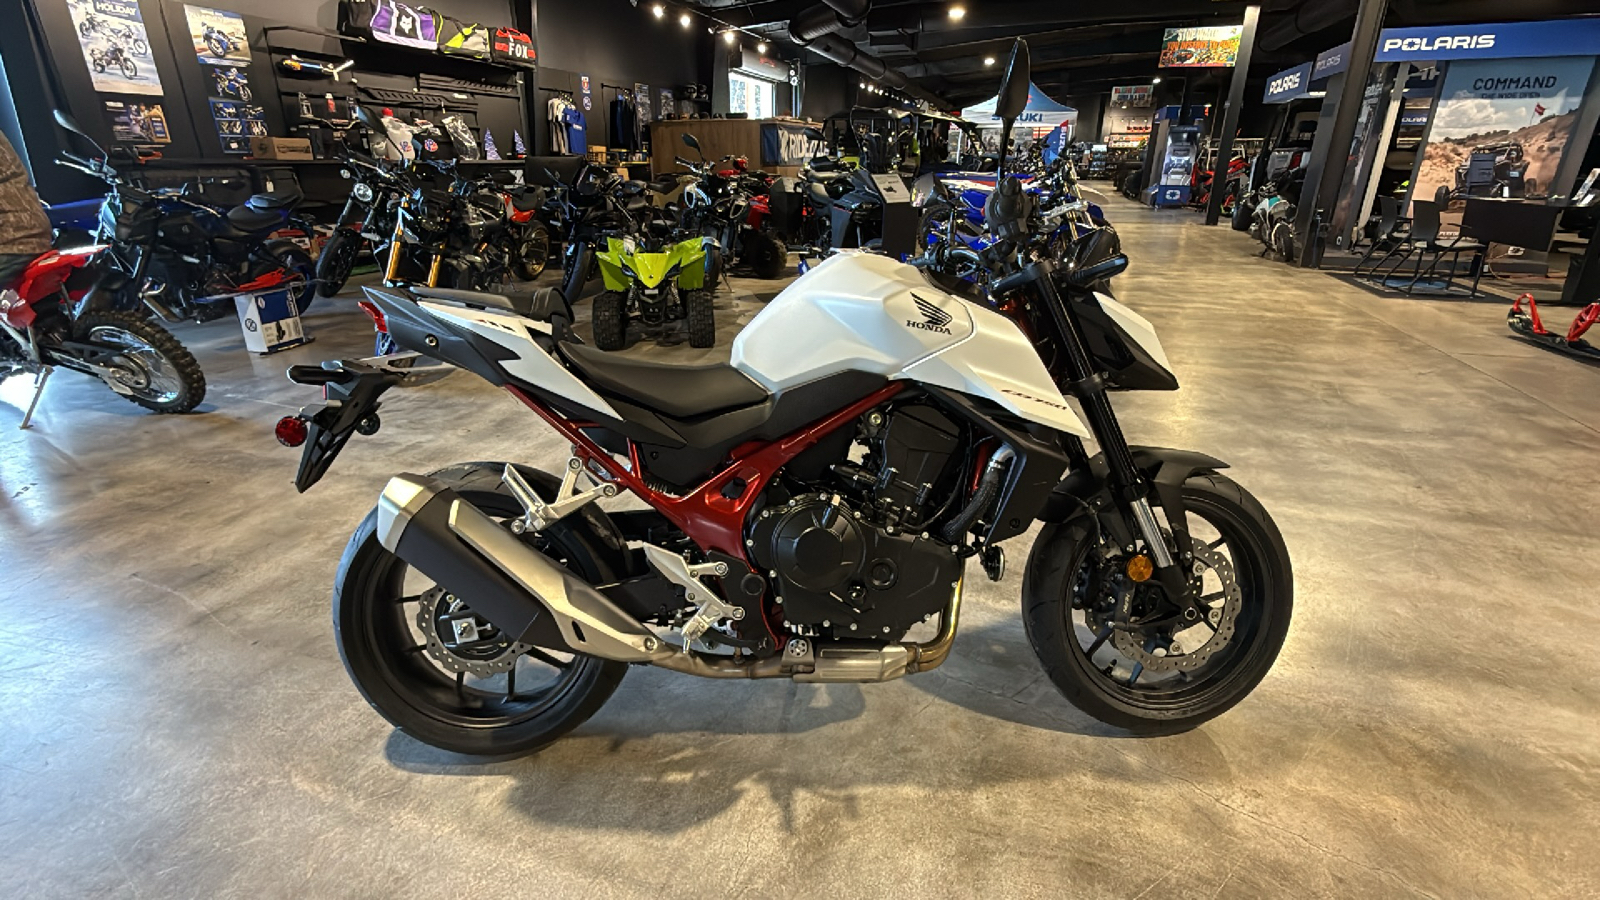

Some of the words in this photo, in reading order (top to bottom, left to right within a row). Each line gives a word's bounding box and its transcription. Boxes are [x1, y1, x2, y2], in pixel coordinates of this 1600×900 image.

[96, 1, 136, 15] HOLIDAY
[508, 42, 529, 59] FOX
[1383, 34, 1496, 53] POLARIS
[1315, 53, 1342, 73] POLARIS
[1268, 71, 1301, 95] POLARIS
[1472, 75, 1557, 91] COMMAND
[991, 112, 1043, 122] SUKI
[906, 320, 952, 336] HONDA
